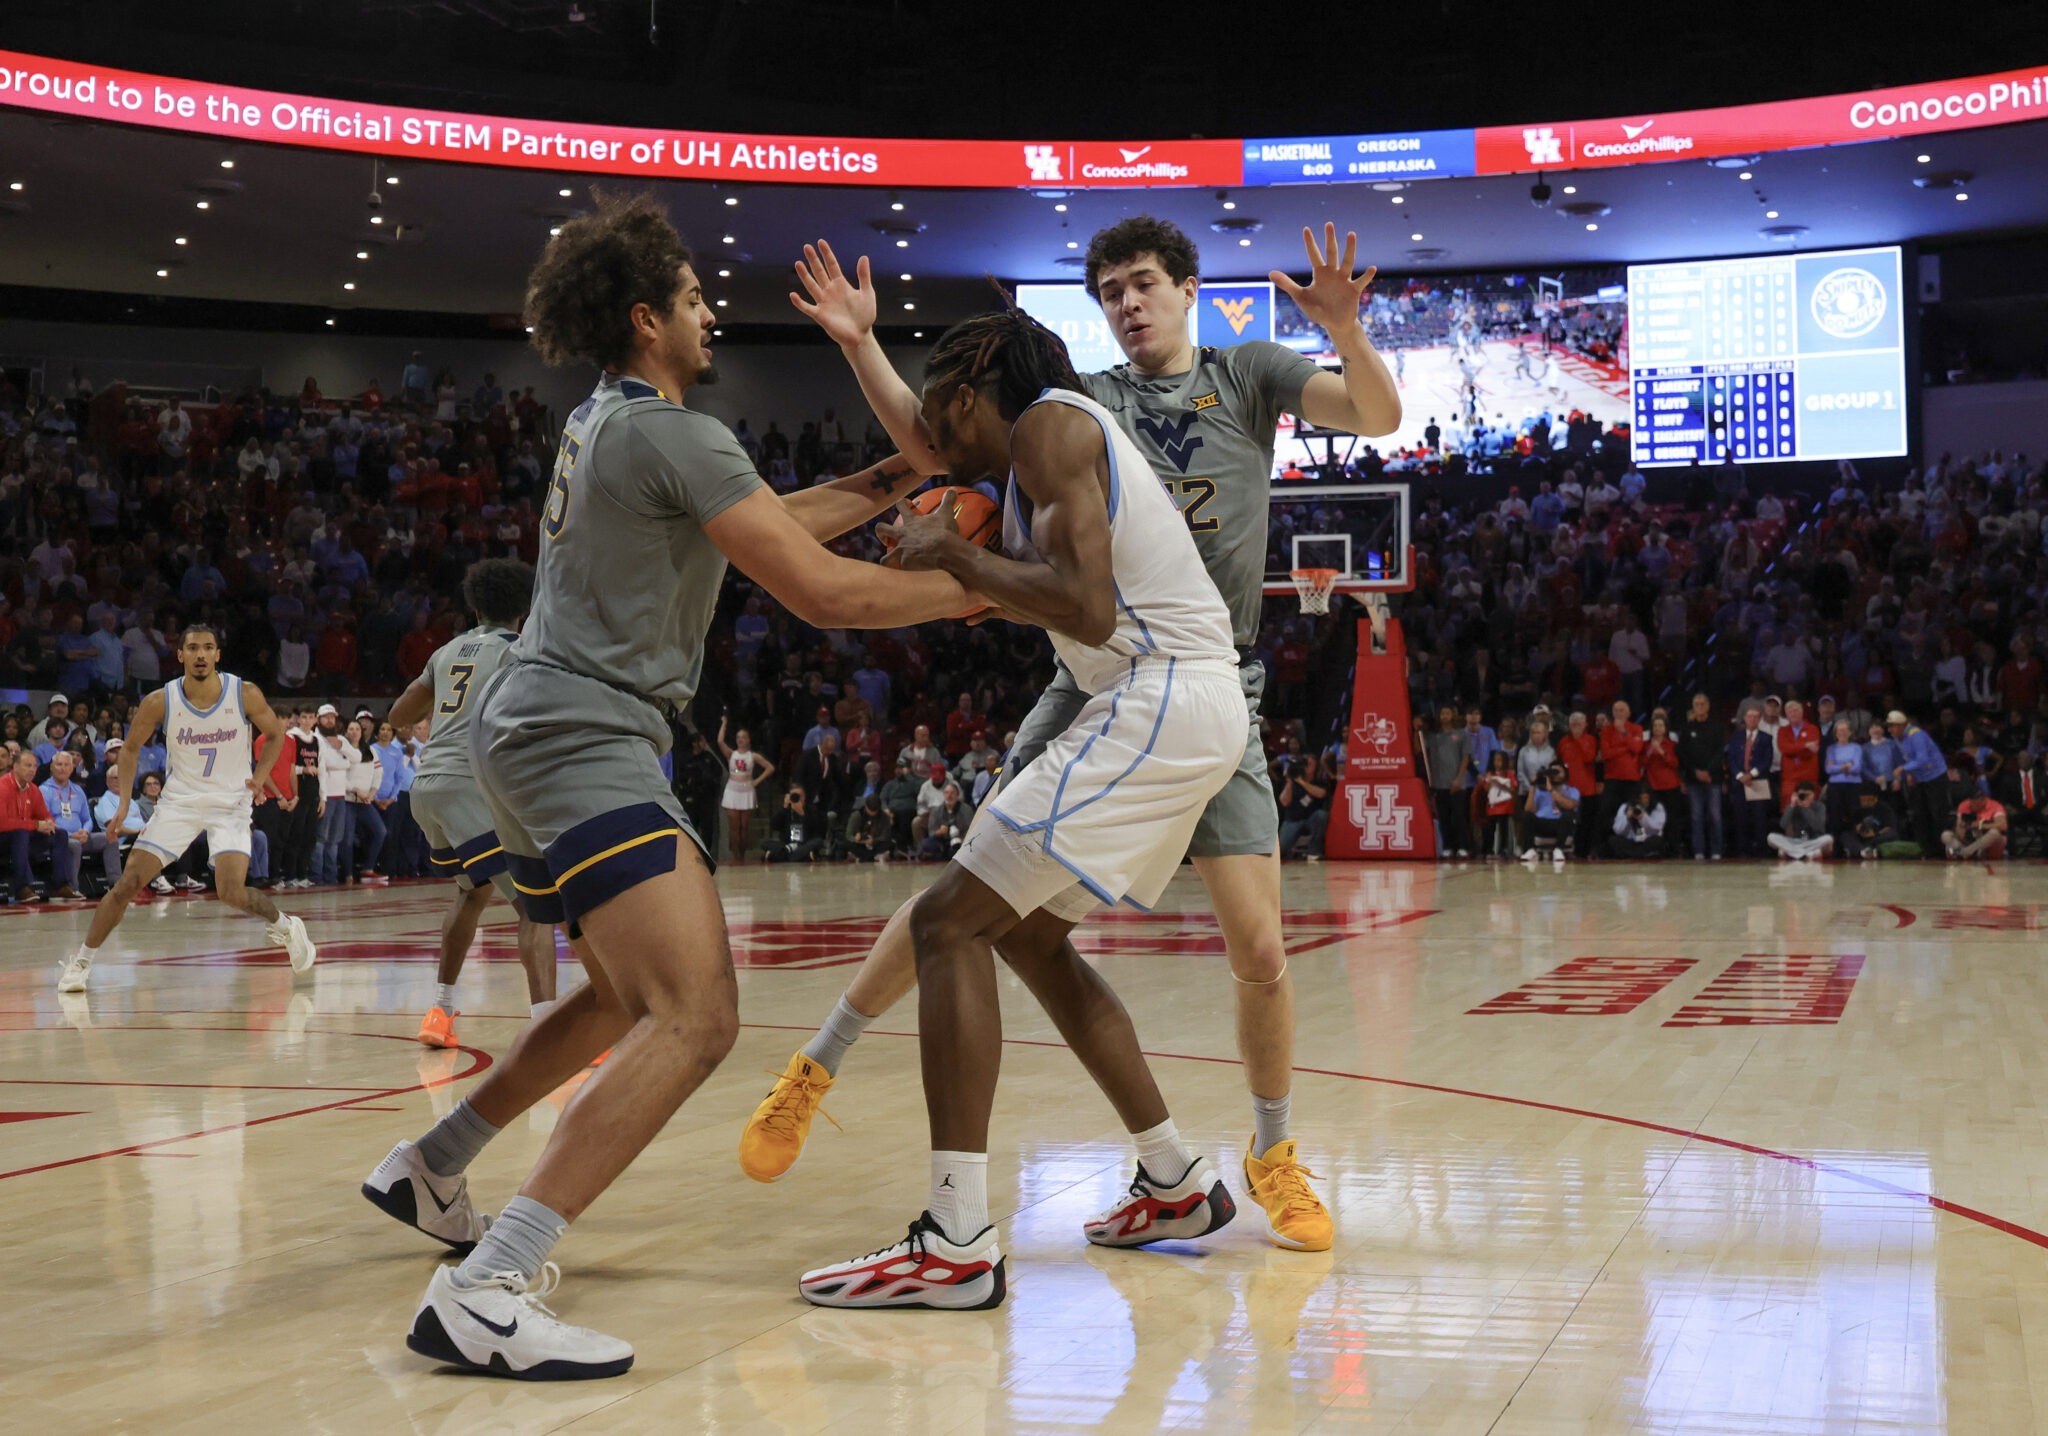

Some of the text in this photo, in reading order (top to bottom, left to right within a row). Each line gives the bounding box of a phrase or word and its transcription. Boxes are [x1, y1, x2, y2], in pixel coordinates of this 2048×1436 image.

[105, 81, 143, 109] to
[154, 86, 197, 117] be
[205, 95, 262, 127] the
[271, 103, 392, 142] Official
[401, 117, 491, 151] STEM
[502, 126, 623, 161] Partner
[630, 139, 665, 164] of
[673, 140, 721, 167] UH
[730, 144, 878, 173] Athletics
[1259, 144, 1333, 162] BASKETBALL
[1357, 138, 1421, 153] OREGON
[1522, 128, 1564, 164] UH
[1583, 134, 1693, 158] ConocoPhillips
[1024, 146, 1063, 180] UH
[1081, 158, 1188, 180] ConocoPhillips
[1302, 162, 1334, 176] 8:00
[1358, 158, 1437, 174] NEBRASKA
[1164, 478, 1220, 533] 2
[457, 643, 482, 658] HUFF
[439, 664, 475, 715] 3
[176, 728, 237, 745] Houston
[198, 748, 217, 777] 7
[1345, 784, 1413, 850] UH
